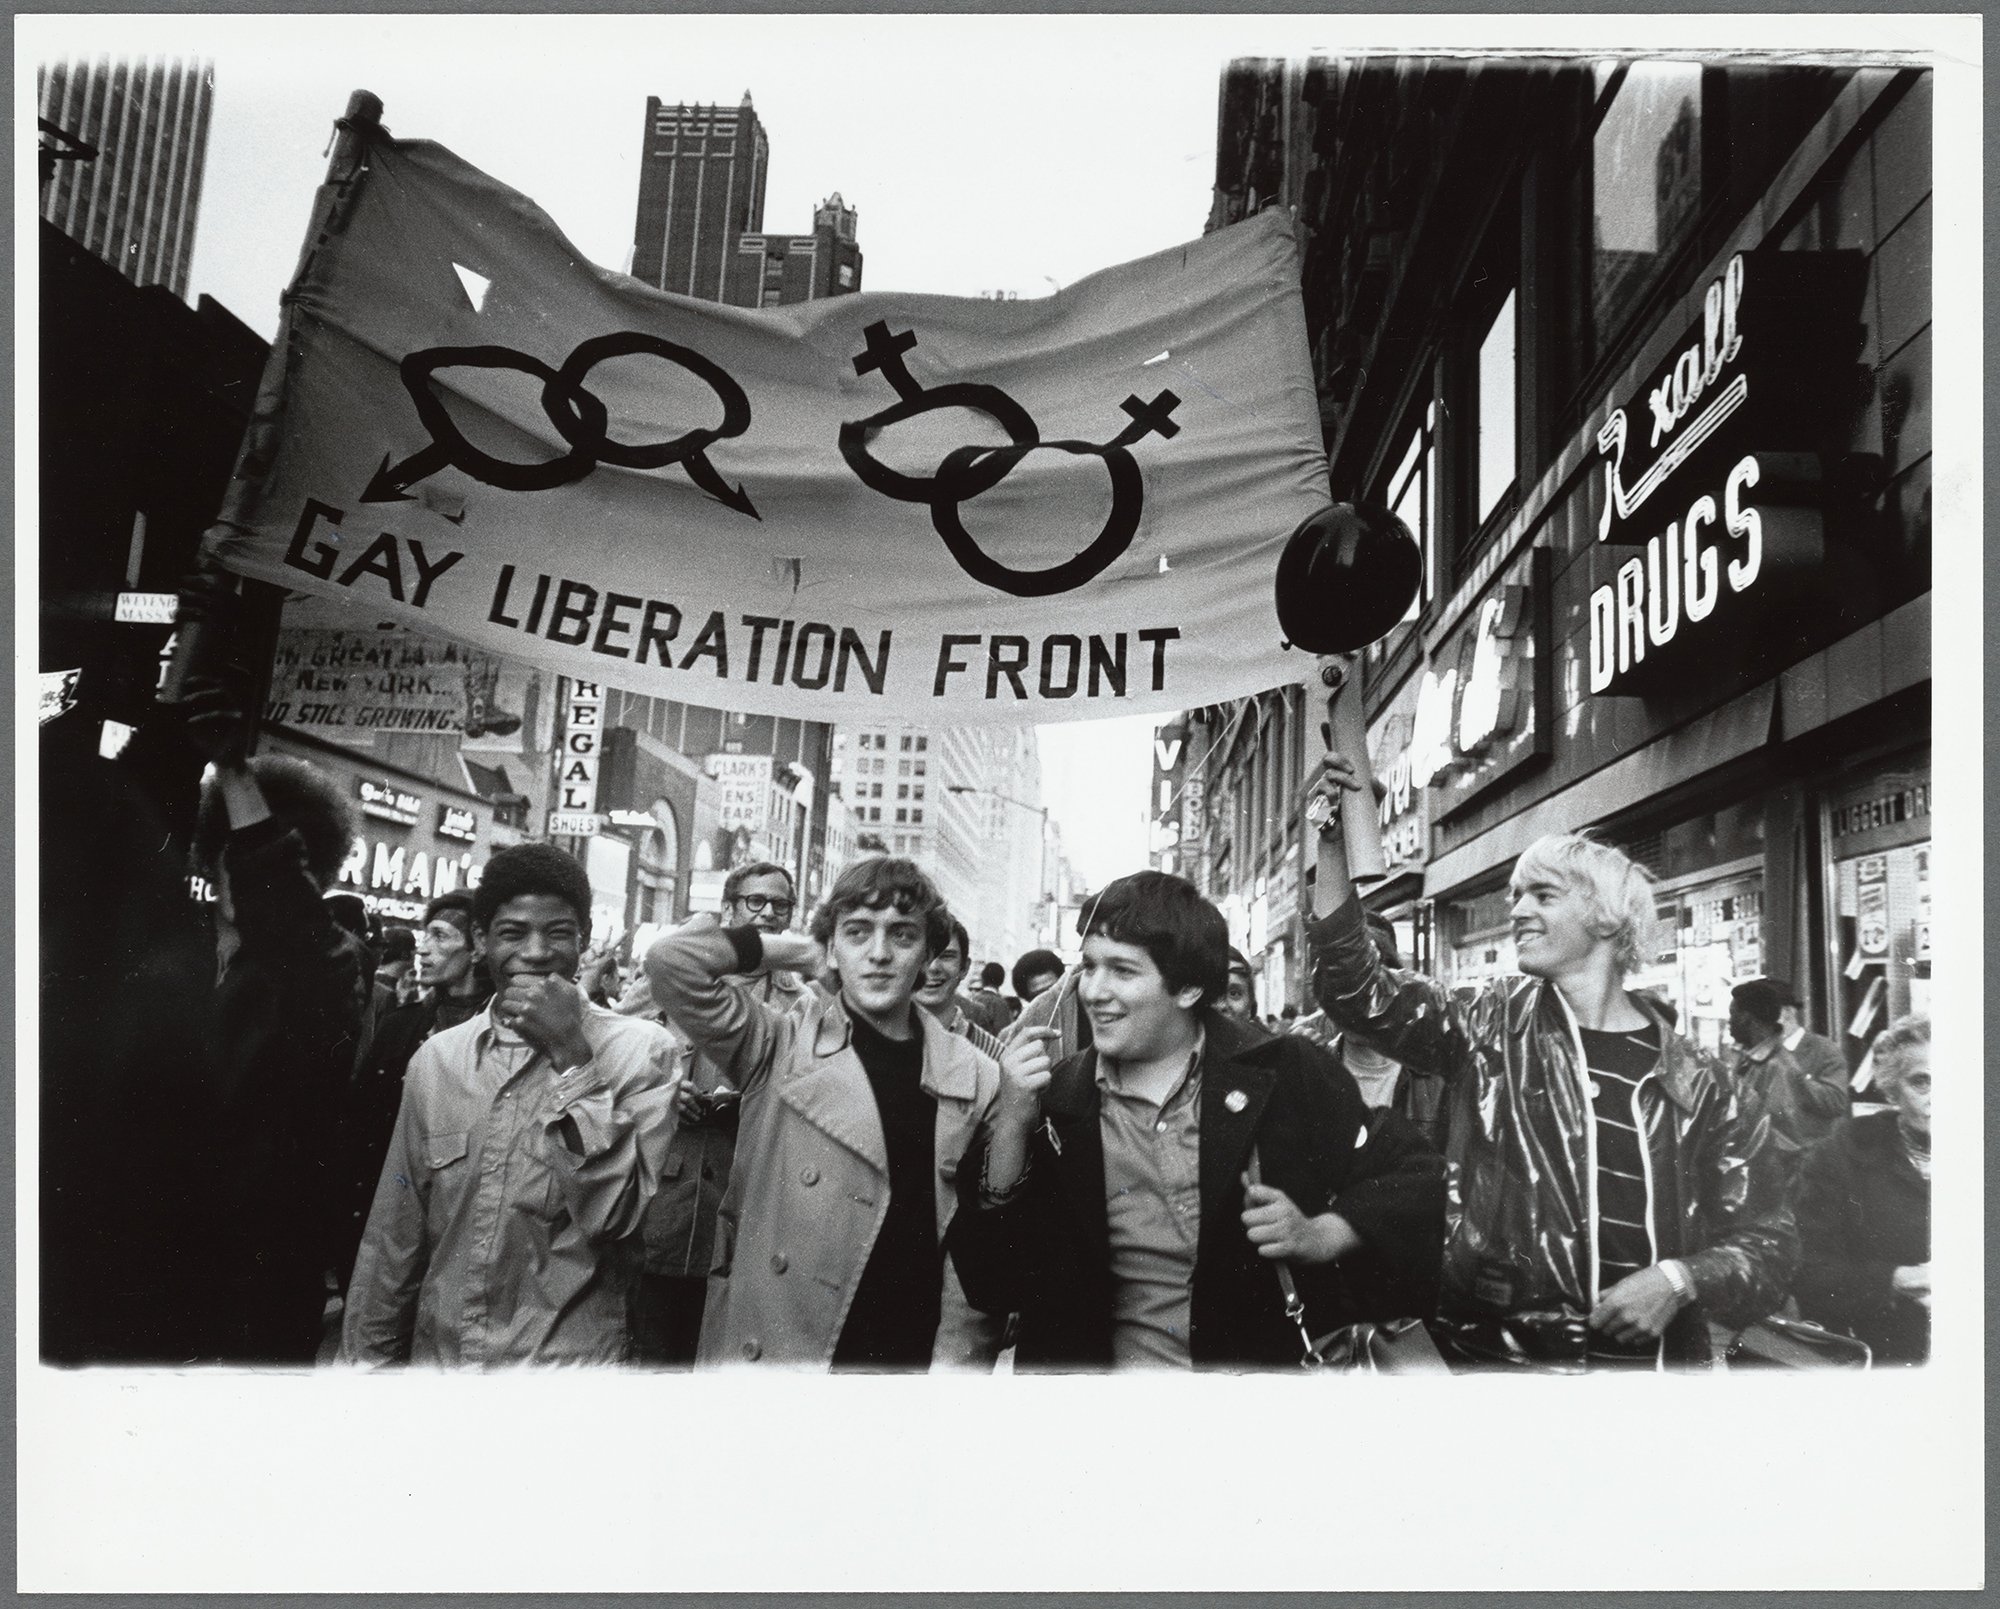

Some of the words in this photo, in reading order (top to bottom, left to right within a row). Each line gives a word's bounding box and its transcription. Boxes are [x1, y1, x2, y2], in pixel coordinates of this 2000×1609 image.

[1597, 254, 1747, 541] Rxall
[1590, 456, 1763, 694] DRUGS
[281, 496, 465, 608] GAY
[487, 564, 892, 695] LIBERATION
[933, 627, 1182, 699] FRONT
[294, 703, 349, 726] STILL
[724, 789, 755, 804] ENS
[722, 805, 754, 820] EAR
[551, 817, 596, 833] SHOES
